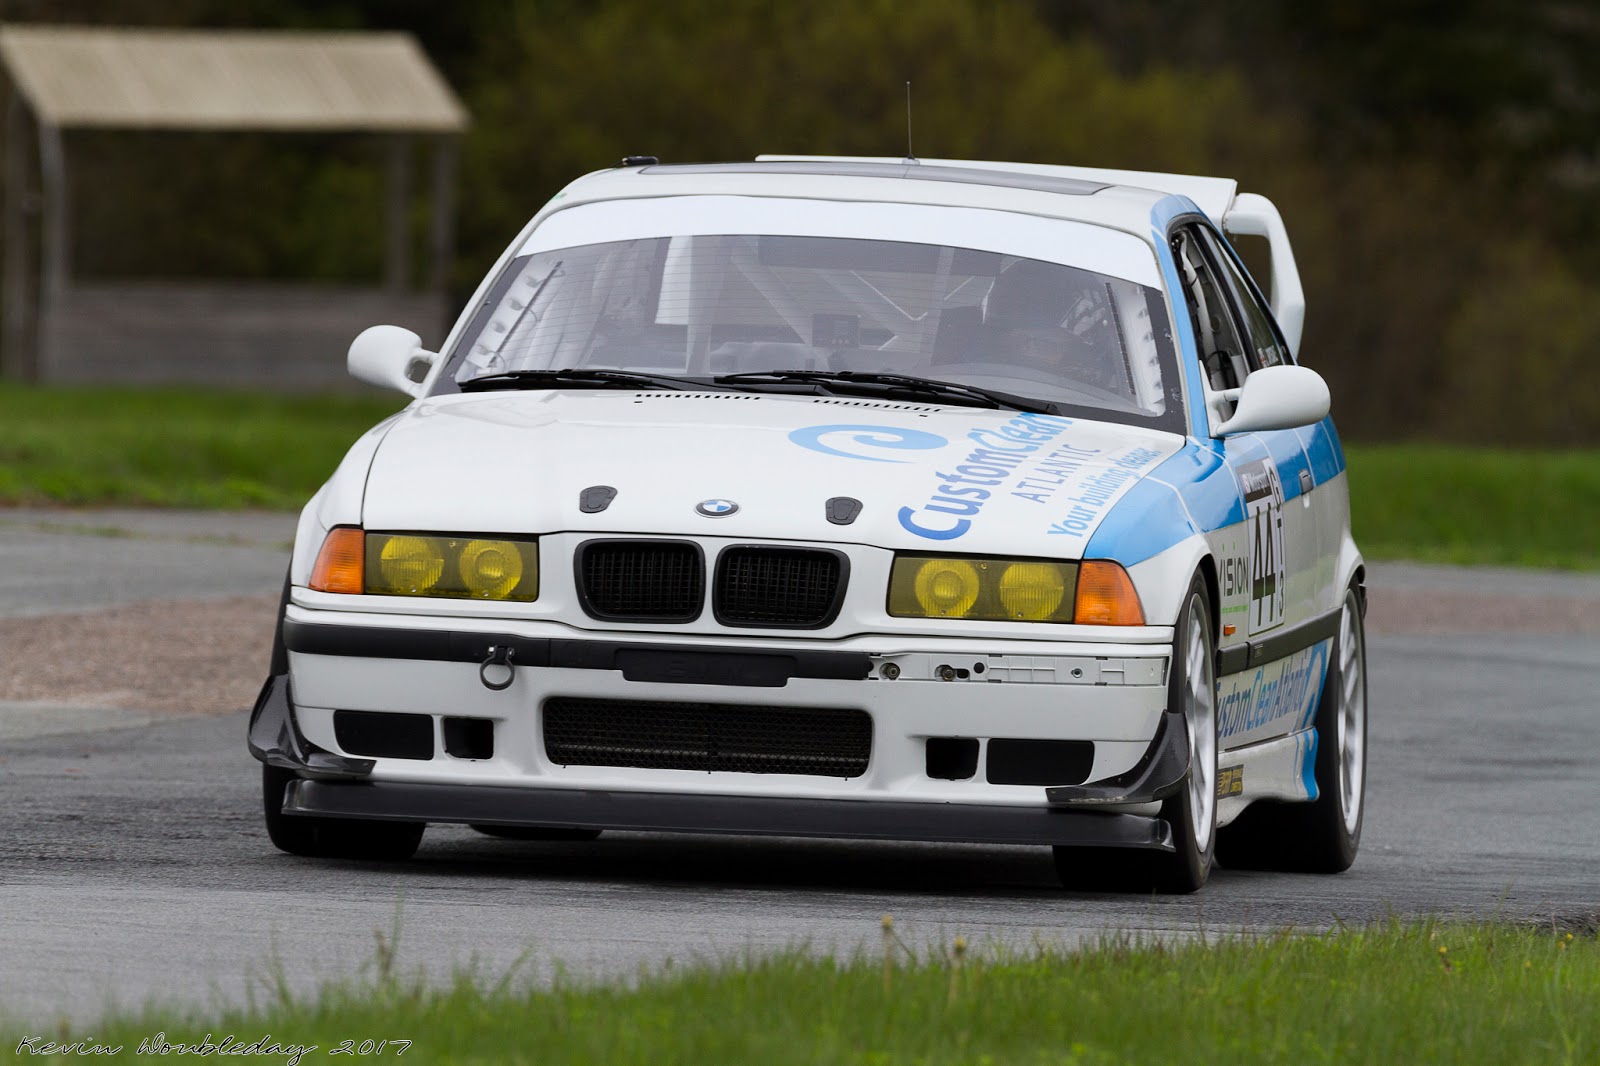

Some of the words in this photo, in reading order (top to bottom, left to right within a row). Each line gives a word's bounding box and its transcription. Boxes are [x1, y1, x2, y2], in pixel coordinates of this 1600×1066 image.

[898, 412, 1074, 541] CustomClean
[1011, 443, 1102, 504] ATLANTIC
[1047, 503, 1098, 538] Your
[1252, 502, 1276, 626] 44
